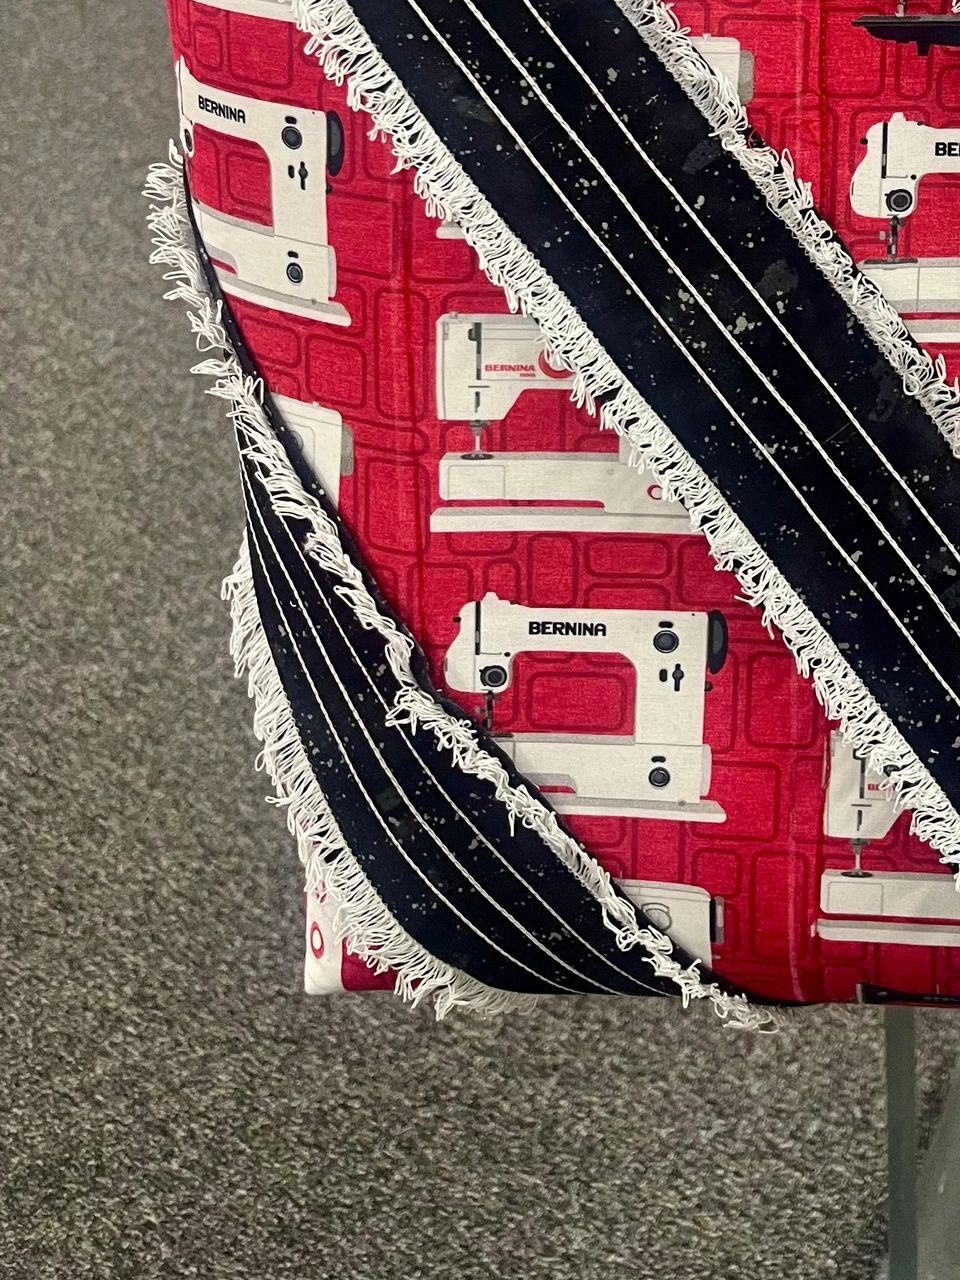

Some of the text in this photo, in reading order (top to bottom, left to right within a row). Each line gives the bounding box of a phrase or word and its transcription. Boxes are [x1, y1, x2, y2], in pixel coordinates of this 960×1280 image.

[198, 94, 246, 124] BERNINA
[484, 363, 536, 372] BERNINA
[528, 621, 607, 637] BERNINA
